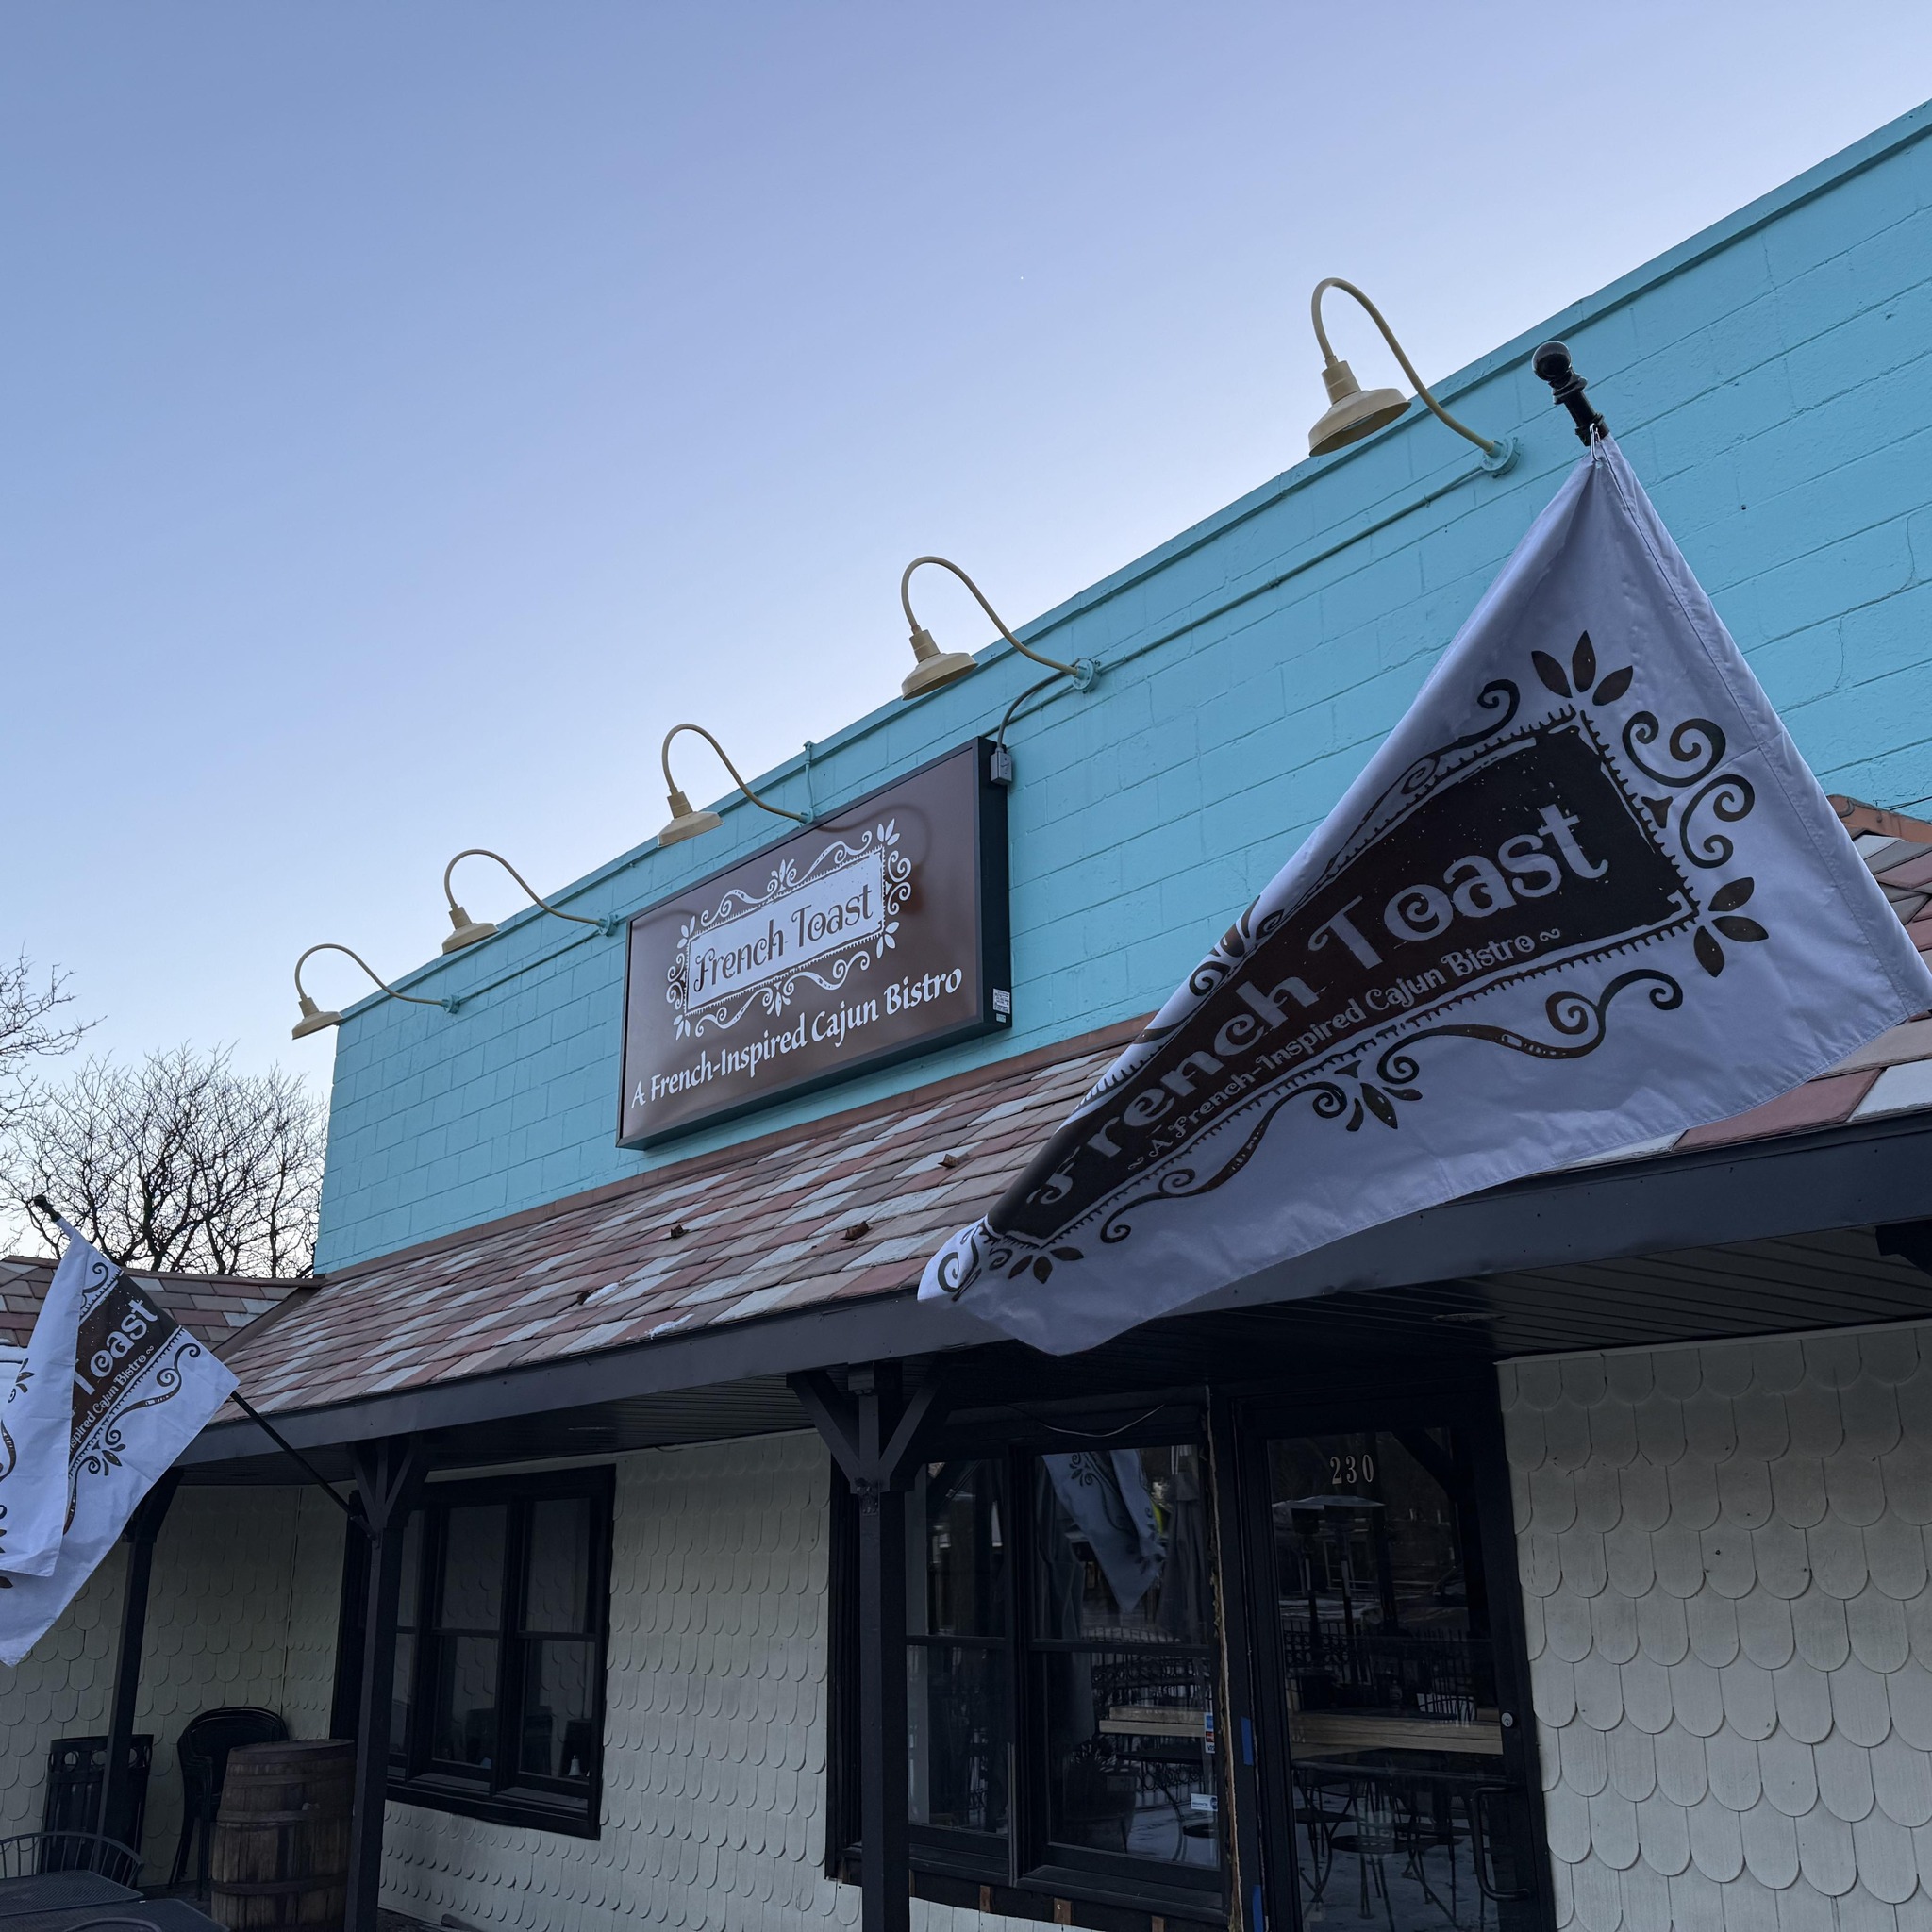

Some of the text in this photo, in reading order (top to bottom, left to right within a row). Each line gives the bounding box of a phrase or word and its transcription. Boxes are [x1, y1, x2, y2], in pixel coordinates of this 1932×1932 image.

[693, 884, 874, 992] French Toast
[1308, 804, 1608, 970] Toast
[631, 1081, 645, 1108] A
[651, 1012, 808, 1101] French-Inspired
[811, 1000, 879, 1048] Cajun
[883, 968, 963, 1016] Bistro
[1149, 935, 1535, 1158] A French-Inspired Cajun Bistro
[92, 1384, 119, 1414] Cajun
[113, 1354, 147, 1387] Bistro
[1330, 1454, 1374, 1485] 230
